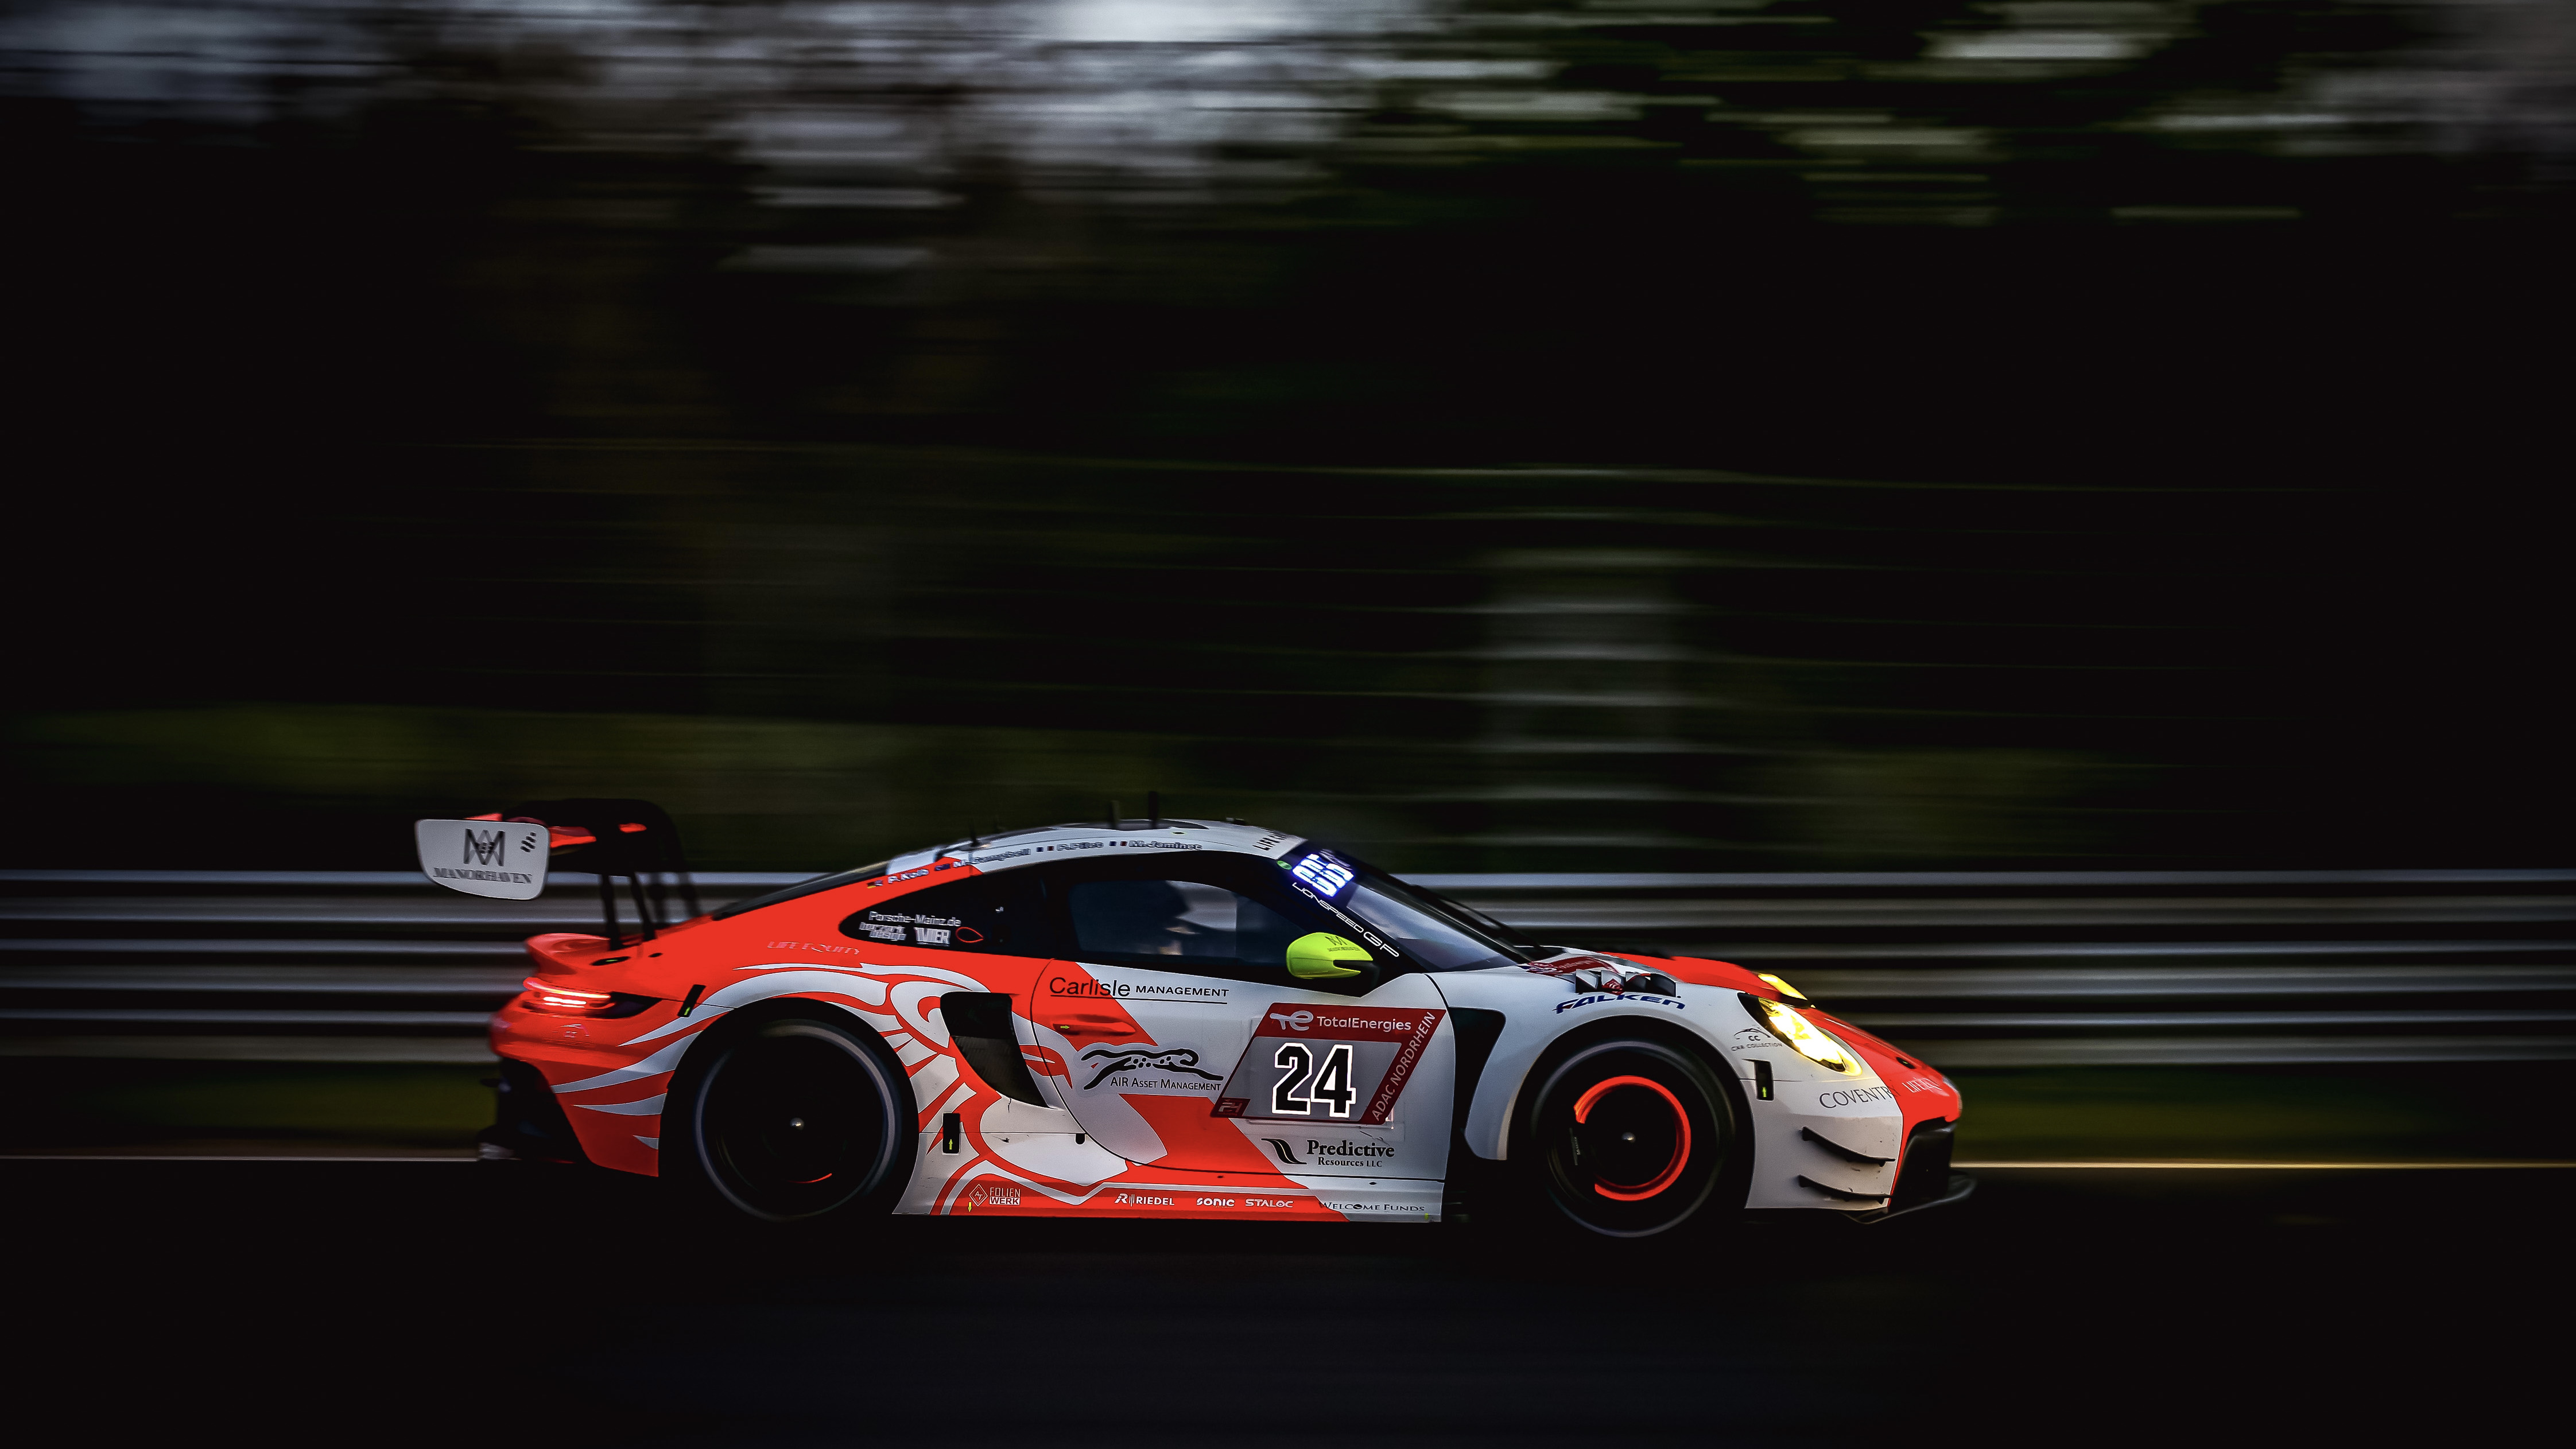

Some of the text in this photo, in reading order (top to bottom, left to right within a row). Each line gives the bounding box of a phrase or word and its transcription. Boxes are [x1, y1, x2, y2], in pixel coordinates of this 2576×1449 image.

[868, 911, 961, 926] Porsche-Mainz.de
[1363, 931, 1399, 957] GP
[1049, 977, 1229, 997] Carlisle MANAGEMENT
[1552, 994, 1686, 1015] FALKEN
[1316, 1016, 1411, 1032] TotalEnergies
[1371, 1012, 1436, 1121] ADAC NORDRHEIN
[1110, 1077, 1128, 1087] AIR
[1272, 1042, 1356, 1118] 24
[1306, 1140, 1395, 1157] Predictive
[1317, 1157, 1383, 1167] Resources LLC
[990, 1187, 1021, 1197] FOLIEN
[1136, 1196, 1174, 1205] RIEDEL
[1245, 1199, 1294, 1208] STALOC
